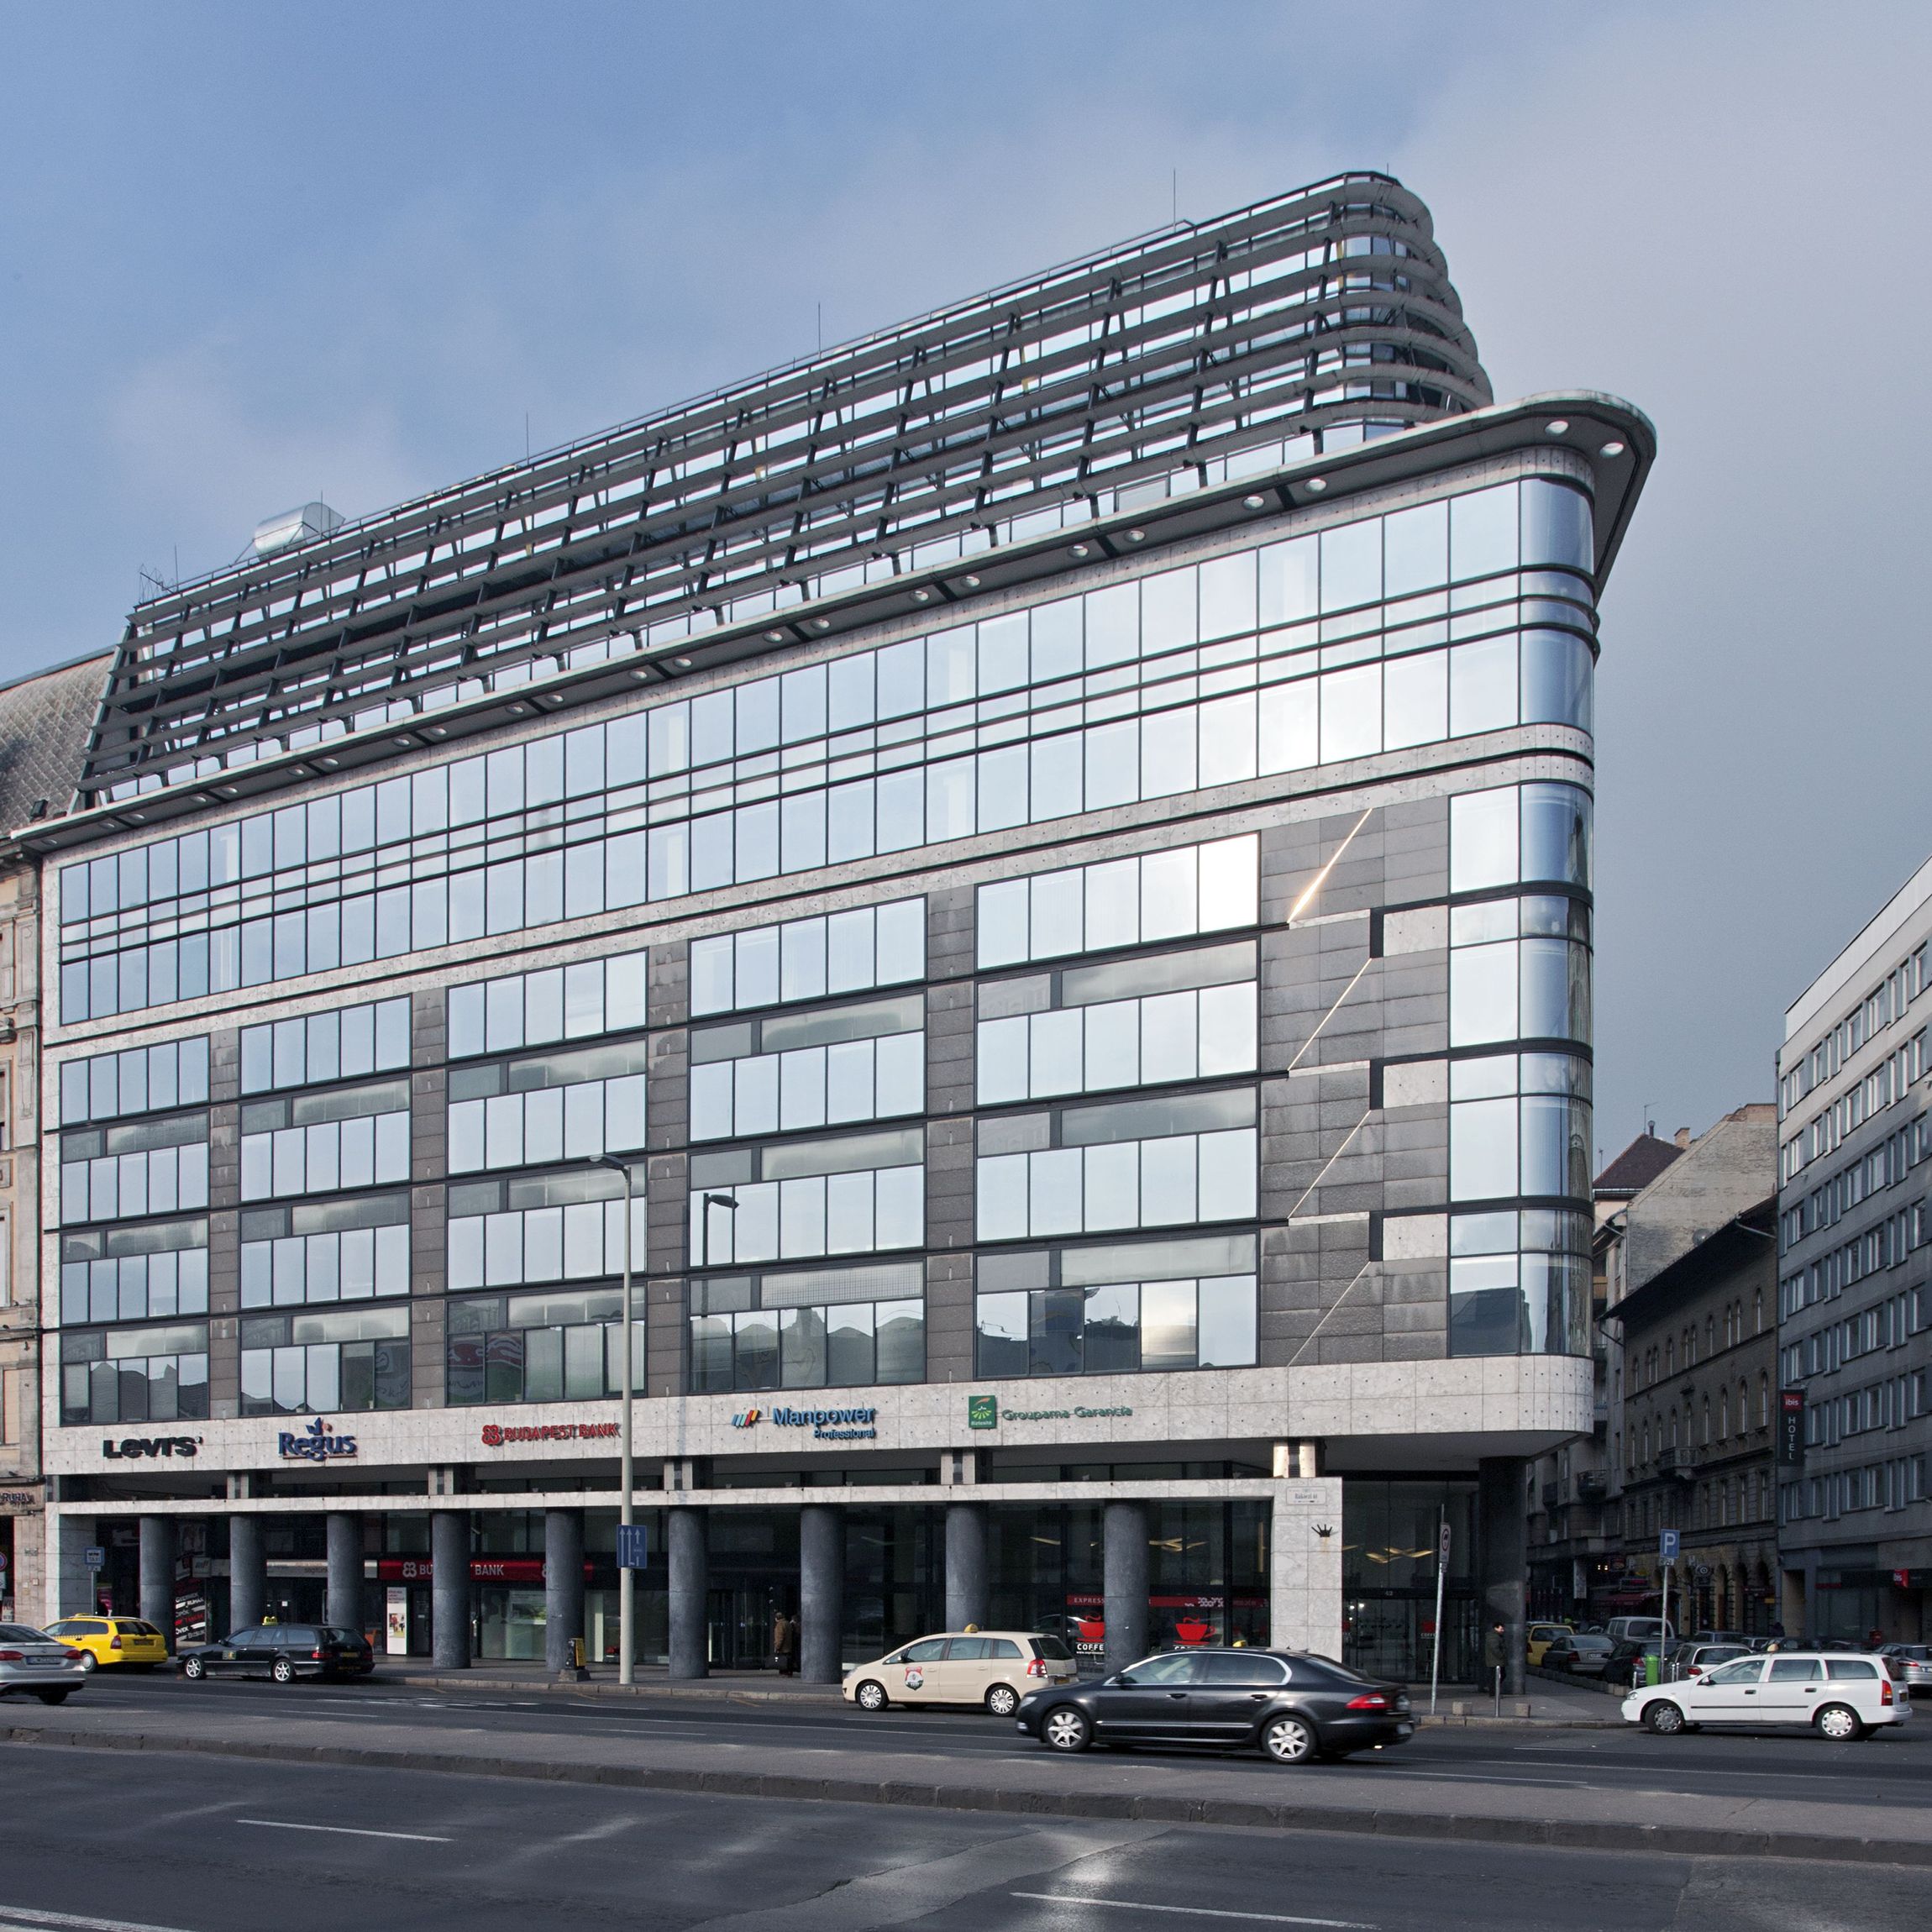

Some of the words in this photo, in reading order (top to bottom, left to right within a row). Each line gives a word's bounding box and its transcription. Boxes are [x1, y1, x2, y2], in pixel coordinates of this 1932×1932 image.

[773, 1408, 875, 1428] Manpower
[1002, 1409, 1070, 1421] Groupama
[504, 1425, 575, 1441] BUDAPEST
[579, 1423, 620, 1438] BANK
[813, 1429, 875, 1439] Professional
[278, 1432, 357, 1462] Regus
[1664, 1533, 1676, 1553] P
[475, 1564, 504, 1576] BANK
